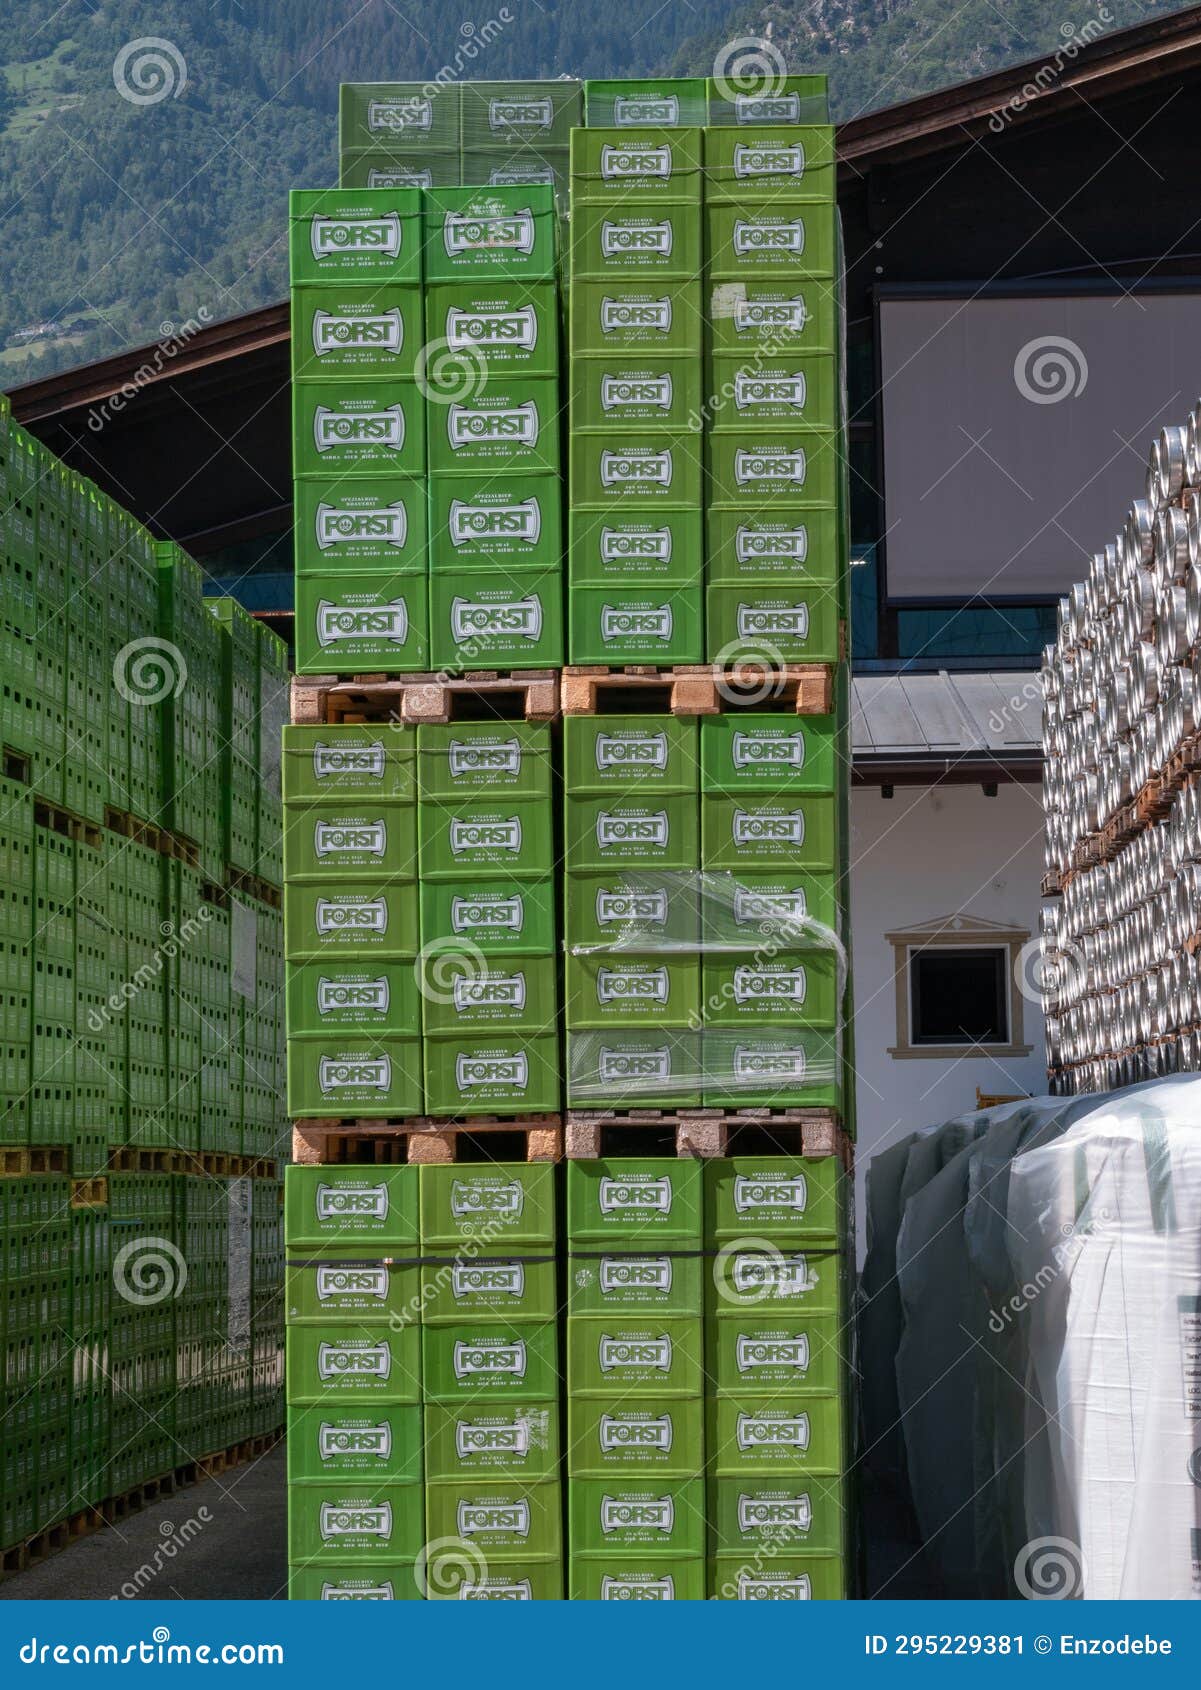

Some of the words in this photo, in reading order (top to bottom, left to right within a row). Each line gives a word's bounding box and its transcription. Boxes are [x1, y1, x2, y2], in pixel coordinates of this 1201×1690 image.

[495, 106, 549, 121] FORST
[620, 104, 674, 120] FORST
[742, 101, 796, 116] FORST
[608, 154, 666, 172] FORST
[740, 152, 798, 170] FORST
[320, 224, 394, 246] FORST
[453, 222, 527, 243] FORST
[608, 230, 666, 248] FORST
[740, 228, 798, 246] FORST
[606, 306, 666, 324] FORST
[740, 305, 800, 323] FORST
[322, 322, 396, 343] FORST
[455, 318, 529, 340] FORST
[608, 383, 666, 401] FORST
[742, 382, 800, 400] FORST
[323, 418, 397, 439] FORST
[457, 414, 531, 436] FORST
[608, 460, 666, 478] FORST
[740, 458, 800, 476] FORST
[325, 514, 399, 536] FORST
[459, 512, 533, 533] FORST
[606, 536, 666, 554] FORST
[742, 535, 802, 553] FORST
[326, 612, 400, 633] FORST
[460, 608, 534, 630] FORST
[608, 614, 666, 632] FORST
[744, 612, 802, 630] FORST
[320, 751, 380, 769] FORST
[456, 749, 514, 767] FORST
[602, 743, 662, 761] FORST
[740, 742, 798, 760] FORST
[456, 826, 516, 844] FORST
[604, 821, 662, 839] FORST
[740, 819, 798, 837] FORST
[322, 830, 380, 848] FORST
[322, 907, 382, 925] FORST
[458, 905, 516, 923] FORST
[602, 898, 662, 916] FORST
[740, 898, 800, 916] FORST
[460, 983, 520, 1001] FORST
[604, 977, 662, 995] FORST
[740, 976, 800, 994] FORST
[324, 986, 384, 1004] FORST
[462, 1062, 522, 1080] FORST
[606, 1056, 664, 1074] FORST
[740, 1055, 800, 1073] FORST
[326, 1065, 384, 1083] FORST
[324, 1193, 382, 1211] FORST
[458, 1190, 516, 1208] FORST
[606, 1186, 666, 1204] FORST
[742, 1185, 800, 1203] FORST
[324, 1272, 382, 1290] FORST
[458, 1270, 518, 1288] FORST
[606, 1266, 666, 1284] FORST
[742, 1264, 800, 1282] FORST
[326, 1352, 384, 1370] FORST
[460, 1350, 520, 1368] FORST
[606, 1344, 666, 1362] FORST
[744, 1344, 802, 1362] FORST
[326, 1432, 384, 1450] FORST
[462, 1430, 522, 1448] FORST
[606, 1425, 666, 1443] FORST
[744, 1423, 802, 1441] FORST
[326, 1512, 386, 1530] FORST
[464, 1509, 524, 1527] FORST
[608, 1505, 666, 1523] FORST
[746, 1504, 804, 1522] FORST
[744, 1584, 805, 1600] FORST
